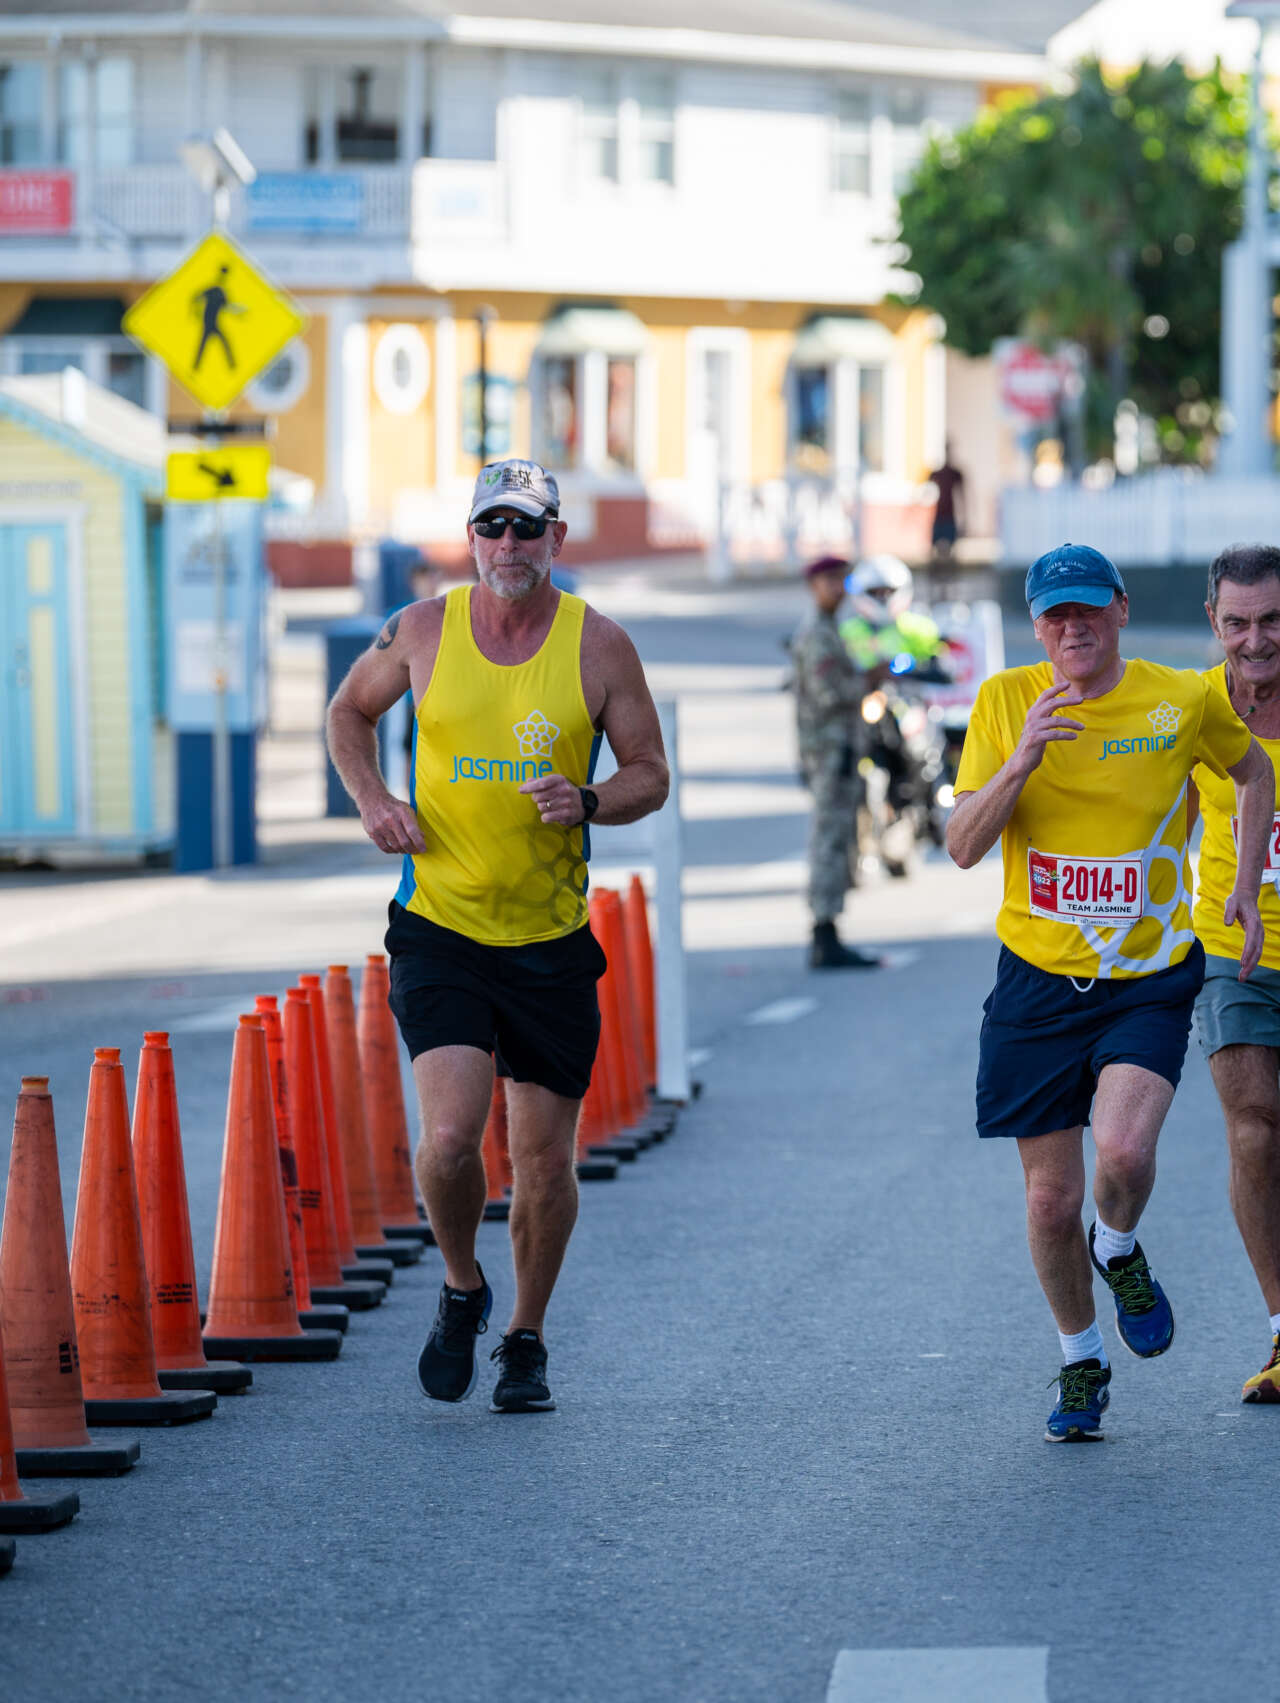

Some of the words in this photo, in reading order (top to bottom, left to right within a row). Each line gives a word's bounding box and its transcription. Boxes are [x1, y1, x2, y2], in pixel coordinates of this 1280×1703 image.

[1098, 734, 1177, 761] jasmine
[449, 755, 553, 783] jasmine
[1062, 864, 1138, 903] 2014-D
[1067, 903, 1091, 912] TEAM
[1093, 905, 1132, 914] JASMINE
